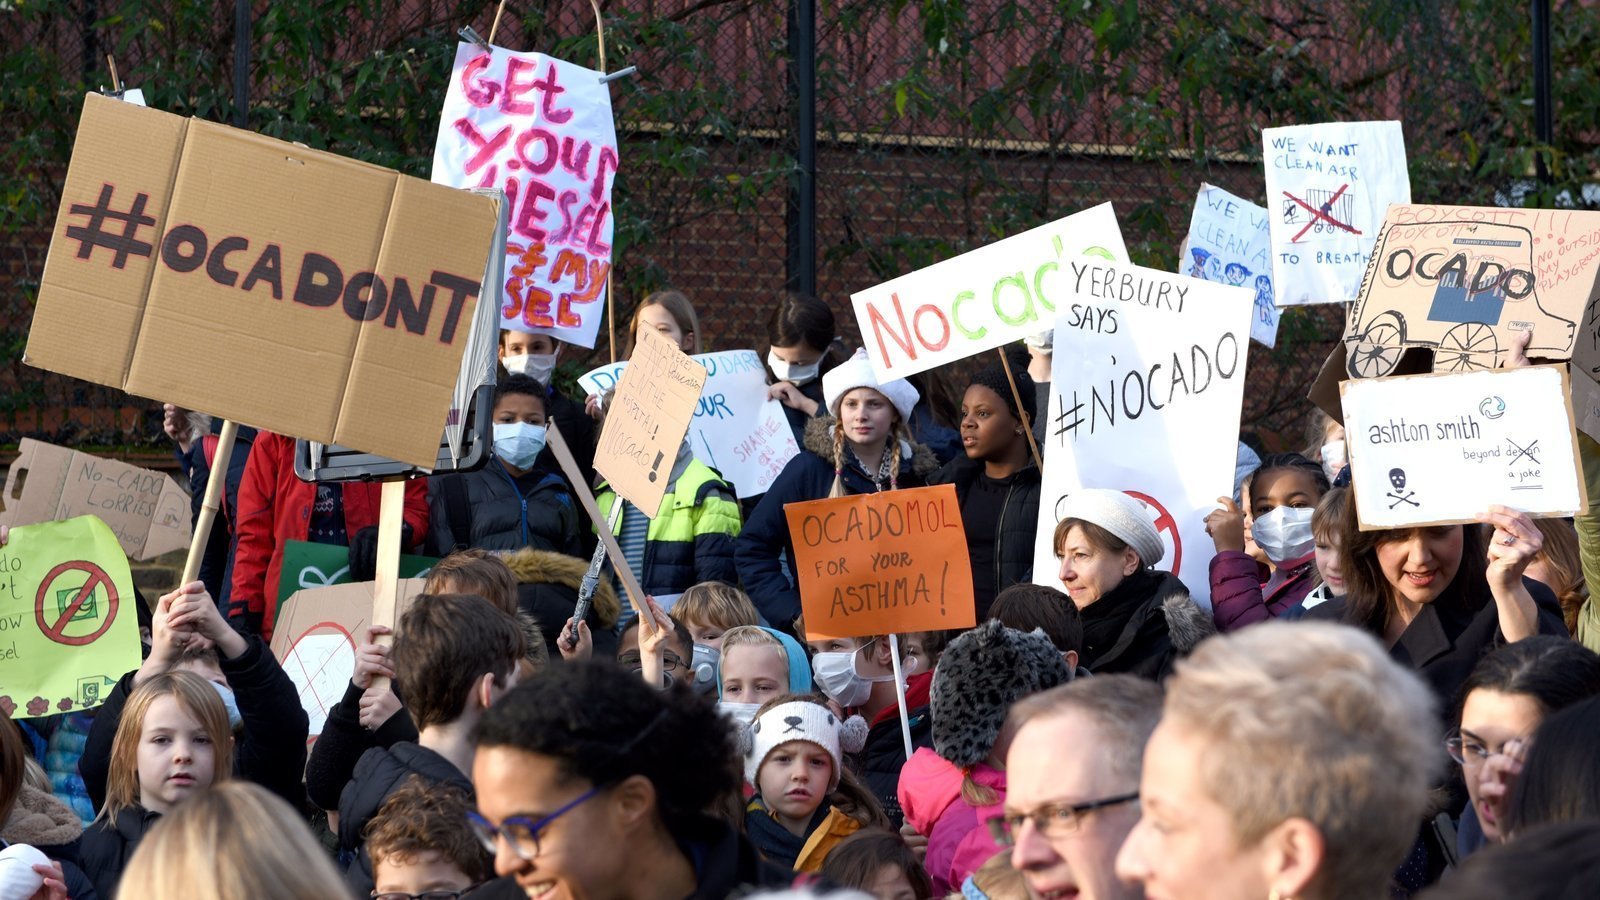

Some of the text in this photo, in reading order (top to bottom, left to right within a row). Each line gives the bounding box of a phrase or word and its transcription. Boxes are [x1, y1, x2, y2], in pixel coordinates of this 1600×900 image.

[1272, 137, 1359, 158] WE WANT
[1274, 155, 1359, 182] CLEAN AIR
[1206, 190, 1240, 219] WE
[1392, 206, 1526, 225] BOYCOTT
[1197, 220, 1250, 256] CLEAN
[1389, 224, 1470, 242] BOYCOTT
[1558, 228, 1600, 256] OUTSID
[65, 182, 484, 346] #OCADONT
[1279, 252, 1300, 265] TO
[1070, 261, 1189, 313] YERBURY
[1385, 248, 1536, 300] OCADO
[1068, 304, 1118, 334] SAYS
[733, 416, 782, 463] SHAME
[1368, 414, 1481, 444] ashton smith
[1462, 444, 1501, 464] beyond
[1520, 468, 1541, 483] joke
[802, 498, 958, 547] OCADOMOL
[815, 552, 913, 578] FOR YOUR
